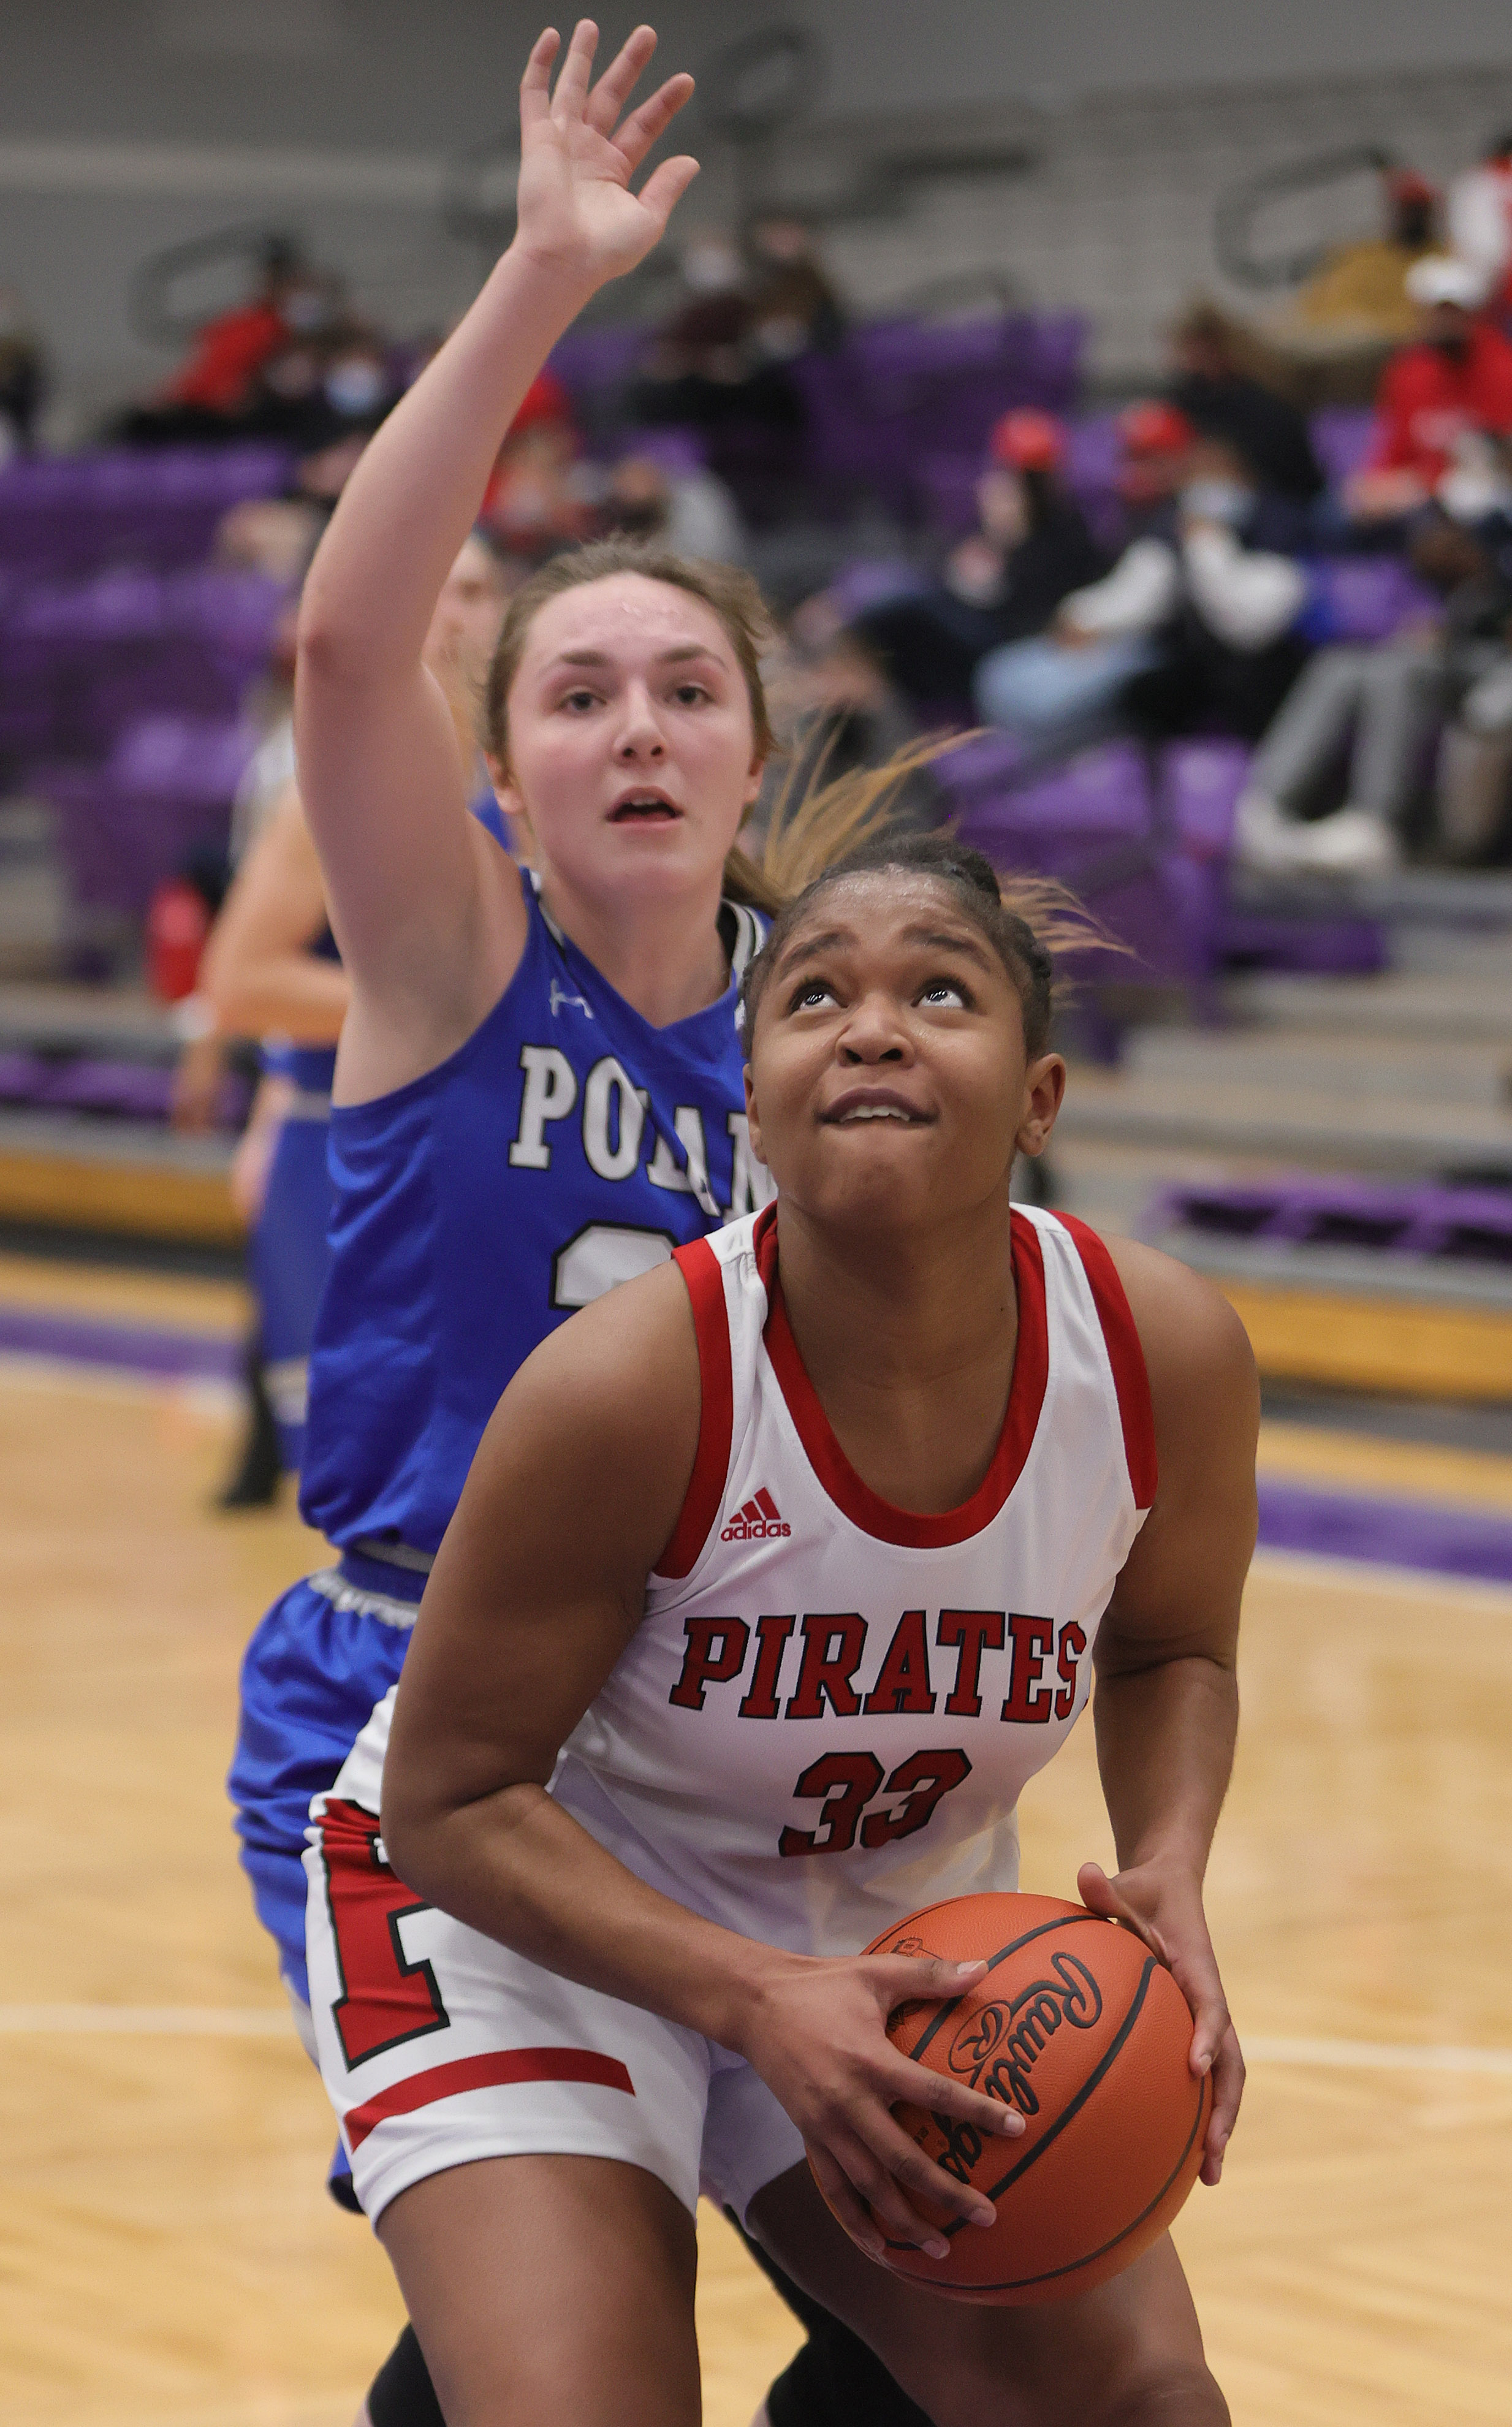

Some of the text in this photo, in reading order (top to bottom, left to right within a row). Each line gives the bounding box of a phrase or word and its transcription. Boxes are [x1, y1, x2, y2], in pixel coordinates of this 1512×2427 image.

[720, 1520, 791, 1541] adidas
[669, 1608, 1088, 1723] PIRATES
[778, 1749, 973, 1858] 33
[928, 1951, 1103, 2185] Rawligs
